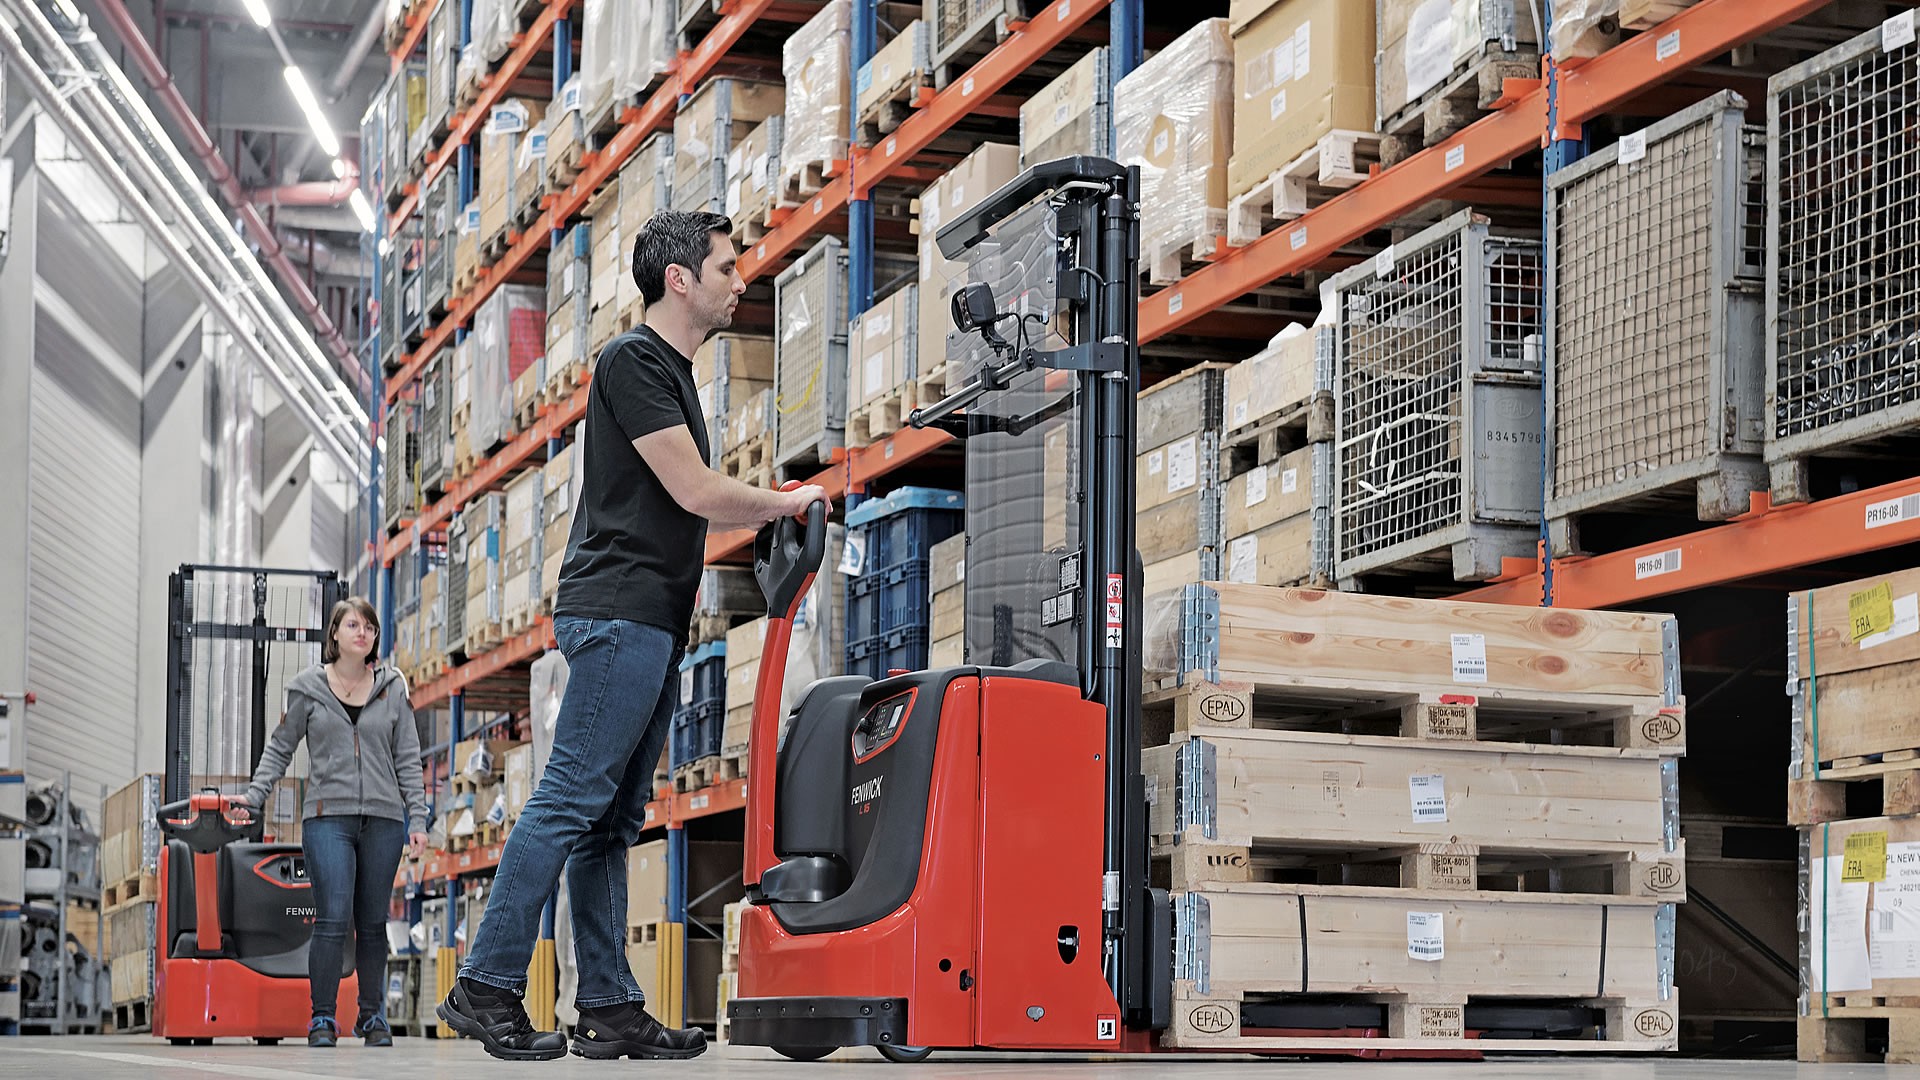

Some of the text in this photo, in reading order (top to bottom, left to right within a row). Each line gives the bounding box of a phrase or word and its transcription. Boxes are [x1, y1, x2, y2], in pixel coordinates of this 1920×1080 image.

[1867, 504, 1899, 523] PR16-08
[1637, 558, 1663, 574] PR16-09
[1855, 614, 1872, 635] FRA
[1207, 699, 1239, 717] EPAL
[1440, 718, 1450, 726] HT
[1648, 719, 1676, 738] EPAL
[850, 774, 884, 806] FENWICK
[1442, 857, 1469, 867] DK-8015
[1897, 853, 1915, 863] NEW
[1443, 866, 1453, 875] HT
[1847, 860, 1862, 876] FRA
[1650, 867, 1673, 887] EUR
[1893, 898, 1903, 907] 09
[1196, 1011, 1228, 1028] EPAL
[1432, 1010, 1459, 1019] DK-8015
[1432, 1019, 1443, 1027] HT
[1641, 1015, 1668, 1031] EPAL
